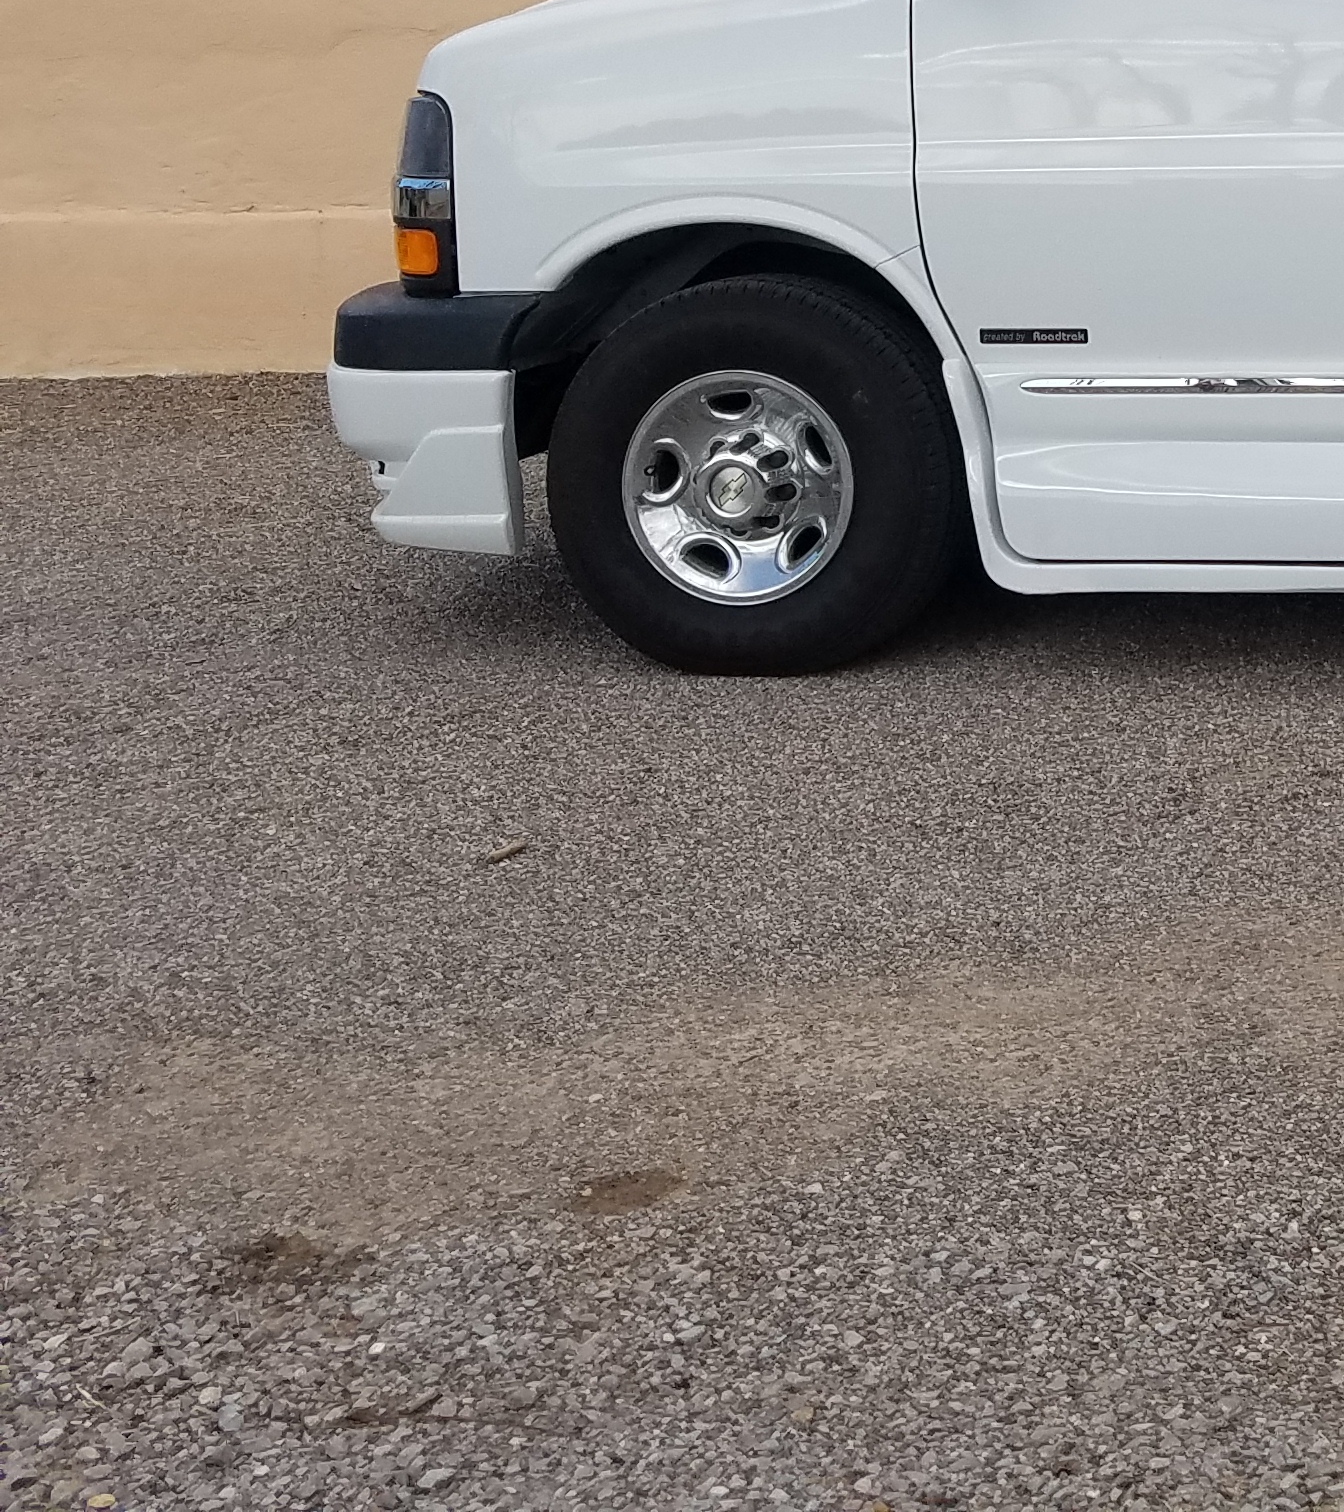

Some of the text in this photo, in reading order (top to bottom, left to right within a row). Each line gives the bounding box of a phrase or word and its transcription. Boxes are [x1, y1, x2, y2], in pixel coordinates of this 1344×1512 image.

[983, 331, 1085, 342] created by Roadtrek
